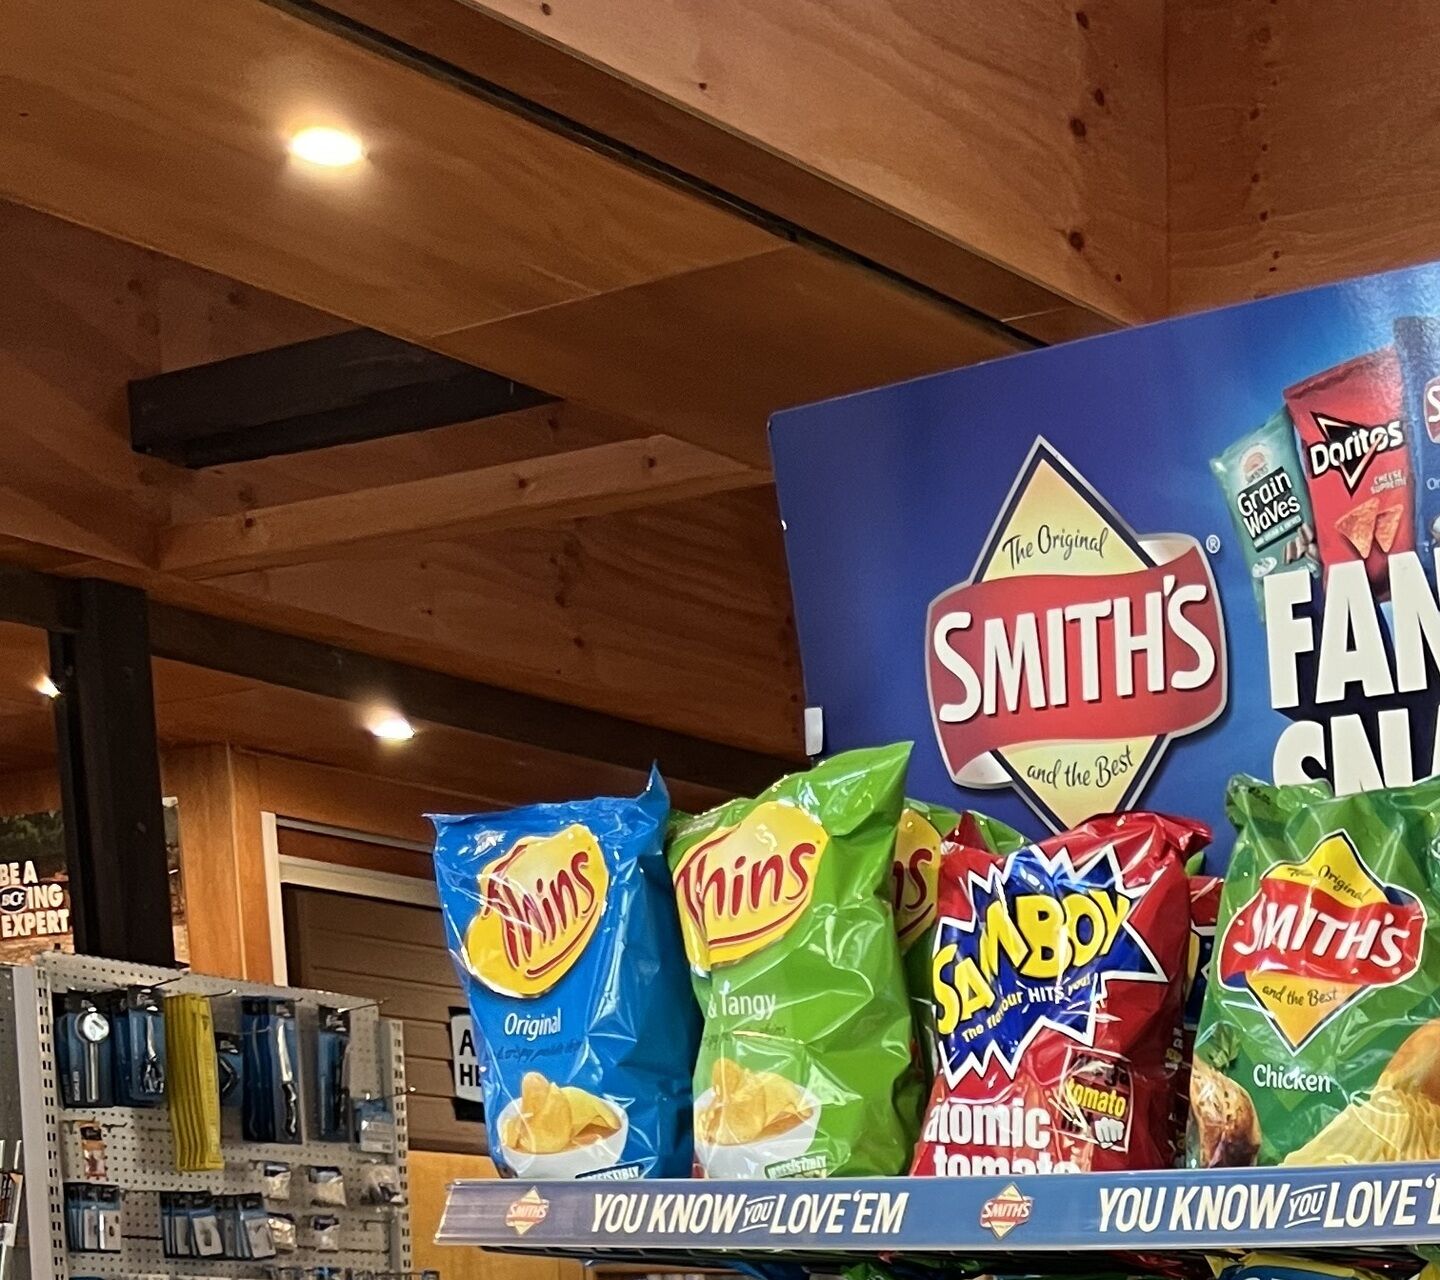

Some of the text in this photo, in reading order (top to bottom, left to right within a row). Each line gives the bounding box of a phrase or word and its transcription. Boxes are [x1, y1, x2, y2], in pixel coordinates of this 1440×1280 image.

[1310, 419, 1404, 476] Doritos
[1237, 471, 1292, 516] Grain
[1243, 495, 1300, 538] Waves
[1002, 523, 1109, 569] The Original
[933, 574, 1216, 722] SMITH'S
[1095, 745, 1134, 789] Best
[23, 860, 38, 884] A
[1318, 864, 1371, 903] Original
[1, 909, 69, 937] EXPERT
[484, 845, 599, 968] Thins
[1232, 895, 1411, 968] SMITH'S
[932, 889, 1131, 1035] SAMBOY
[504, 1008, 562, 1041] Original
[986, 984, 1065, 1031] flavour HITS
[1066, 1077, 1126, 1119] tomato
[1252, 1064, 1332, 1093] Chicken
[923, 1101, 1051, 1150] atomic
[591, 1193, 778, 1234] YOU KNOW YOU
[982, 1199, 1033, 1223] SMITH'S
[1099, 1183, 1326, 1233] YOU KNOW YOU
